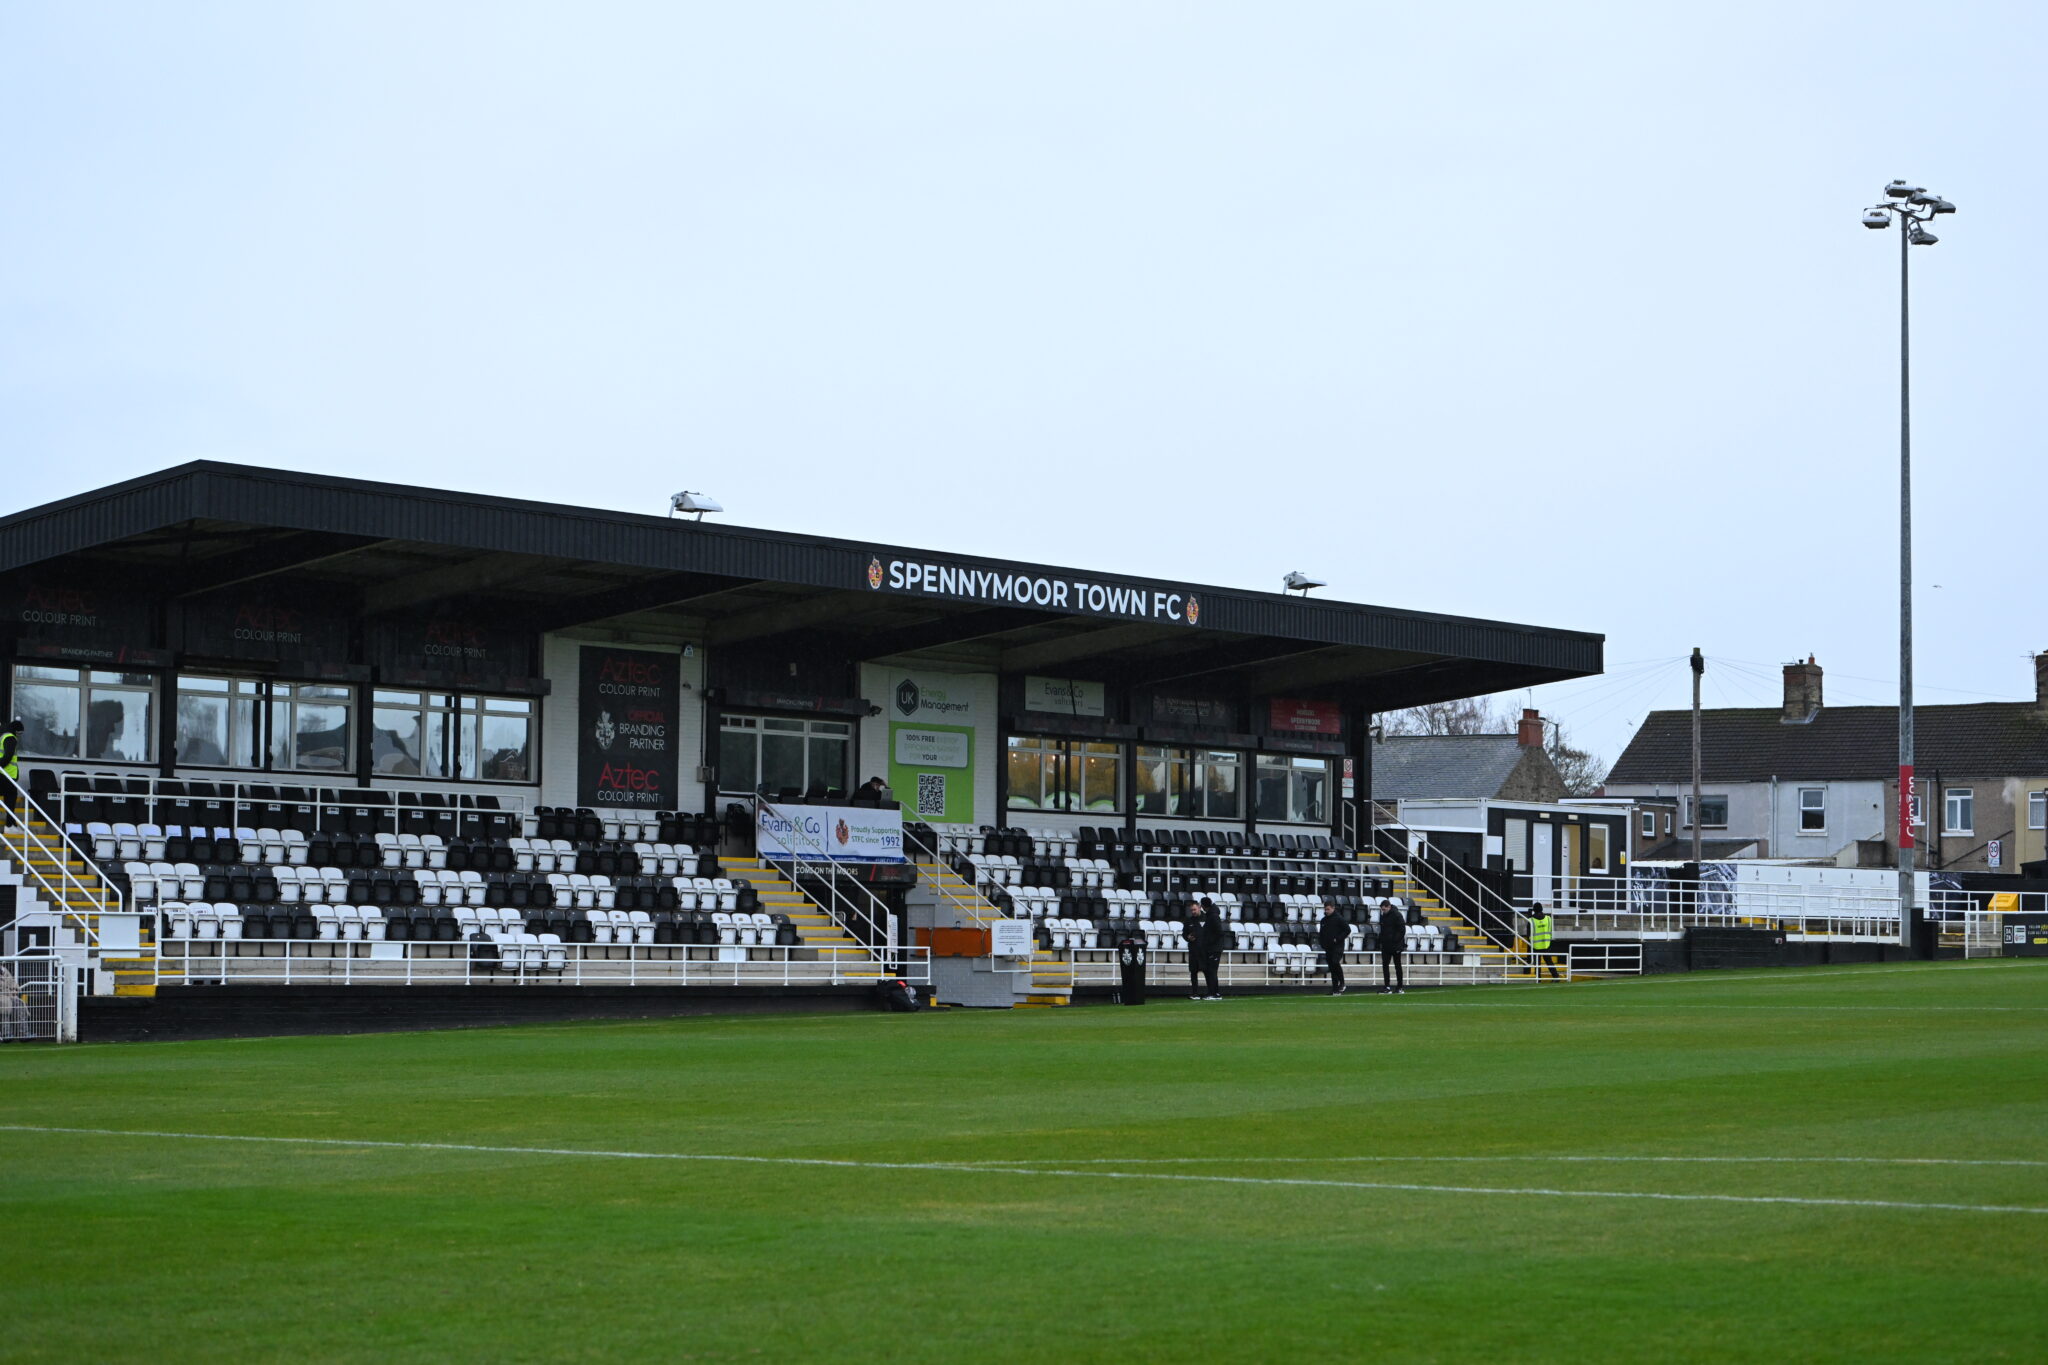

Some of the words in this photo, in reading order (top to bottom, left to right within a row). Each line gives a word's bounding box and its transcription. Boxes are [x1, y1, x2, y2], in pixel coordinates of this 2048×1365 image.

[889, 560, 1067, 607] SPENNYMOOR
[1074, 582, 1146, 617] TOWN
[1154, 592, 1181, 620] FC
[22, 610, 67, 625] COLOUR
[69, 614, 97, 627] PRINT
[233, 628, 275, 641] COLOUR
[277, 631, 302, 644] PRINT
[424, 643, 461, 657] COLOUR
[463, 647, 487, 659] PRINT
[599, 656, 662, 684] Aztec
[599, 683, 636, 696] COLOUR
[638, 686, 661, 697] PRINT
[921, 687, 946, 701] Energy
[901, 690, 915, 705] UK
[1054, 697, 1083, 707] soliciors
[920, 699, 969, 713] Management
[619, 724, 665, 737] BRANDING
[629, 737, 665, 751] PARTNER
[906, 734, 920, 742] 100%
[921, 735, 936, 743] FREE
[922, 753, 938, 761] YOUR
[598, 761, 660, 791] Aztec
[597, 790, 634, 802] COLOUR
[636, 791, 659, 804] PRINT
[851, 825, 871, 834] Proudly
[871, 826, 900, 836] Supporting
[851, 835, 865, 843] STFC
[881, 836, 900, 847] 1992
